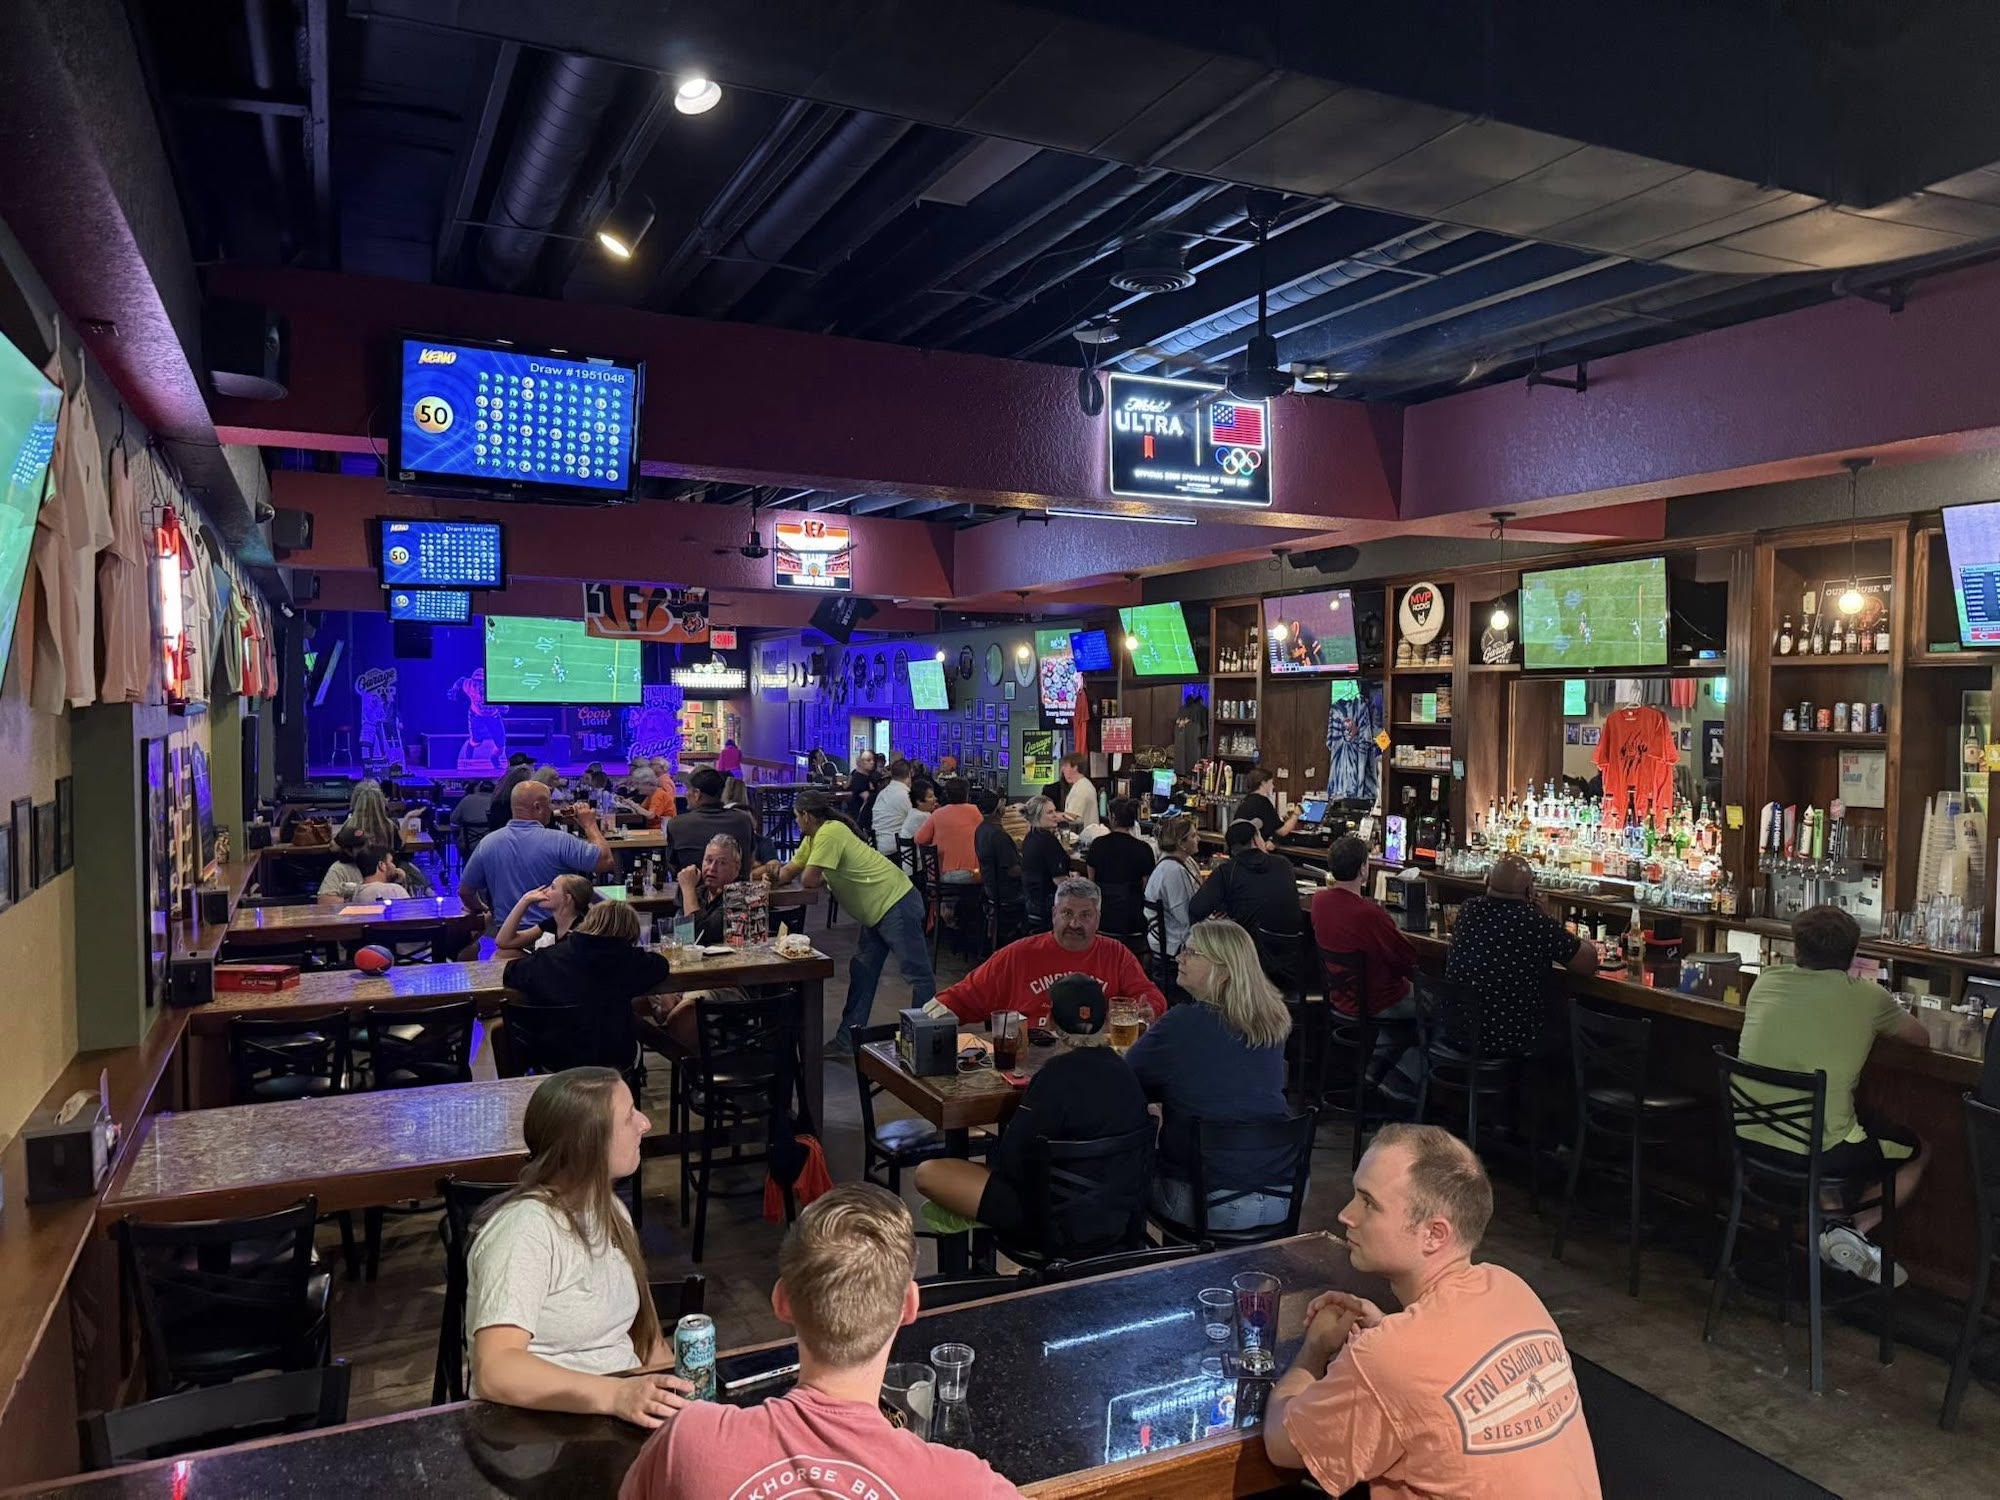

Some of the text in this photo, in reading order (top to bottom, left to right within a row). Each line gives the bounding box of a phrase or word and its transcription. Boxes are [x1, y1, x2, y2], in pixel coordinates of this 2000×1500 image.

[418, 348, 457, 365] KENO
[530, 362, 625, 384] Draw #1951048
[419, 404, 448, 425] 50
[1115, 409, 1184, 437] ULTRA
[391, 551, 408, 562] 50
[1410, 590, 1432, 605] MVP
[358, 670, 395, 692] Garage
[577, 706, 612, 720] Coors
[581, 718, 609, 726] LIGHT
[1023, 735, 1052, 756] Garage
[1463, 1373, 1500, 1415] FIN
[1495, 1343, 1543, 1386] ISLAND
[1483, 1415, 1544, 1441] SIESTA
[1547, 1399, 1564, 1423] KEY
[850, 1478, 880, 1500] BR
